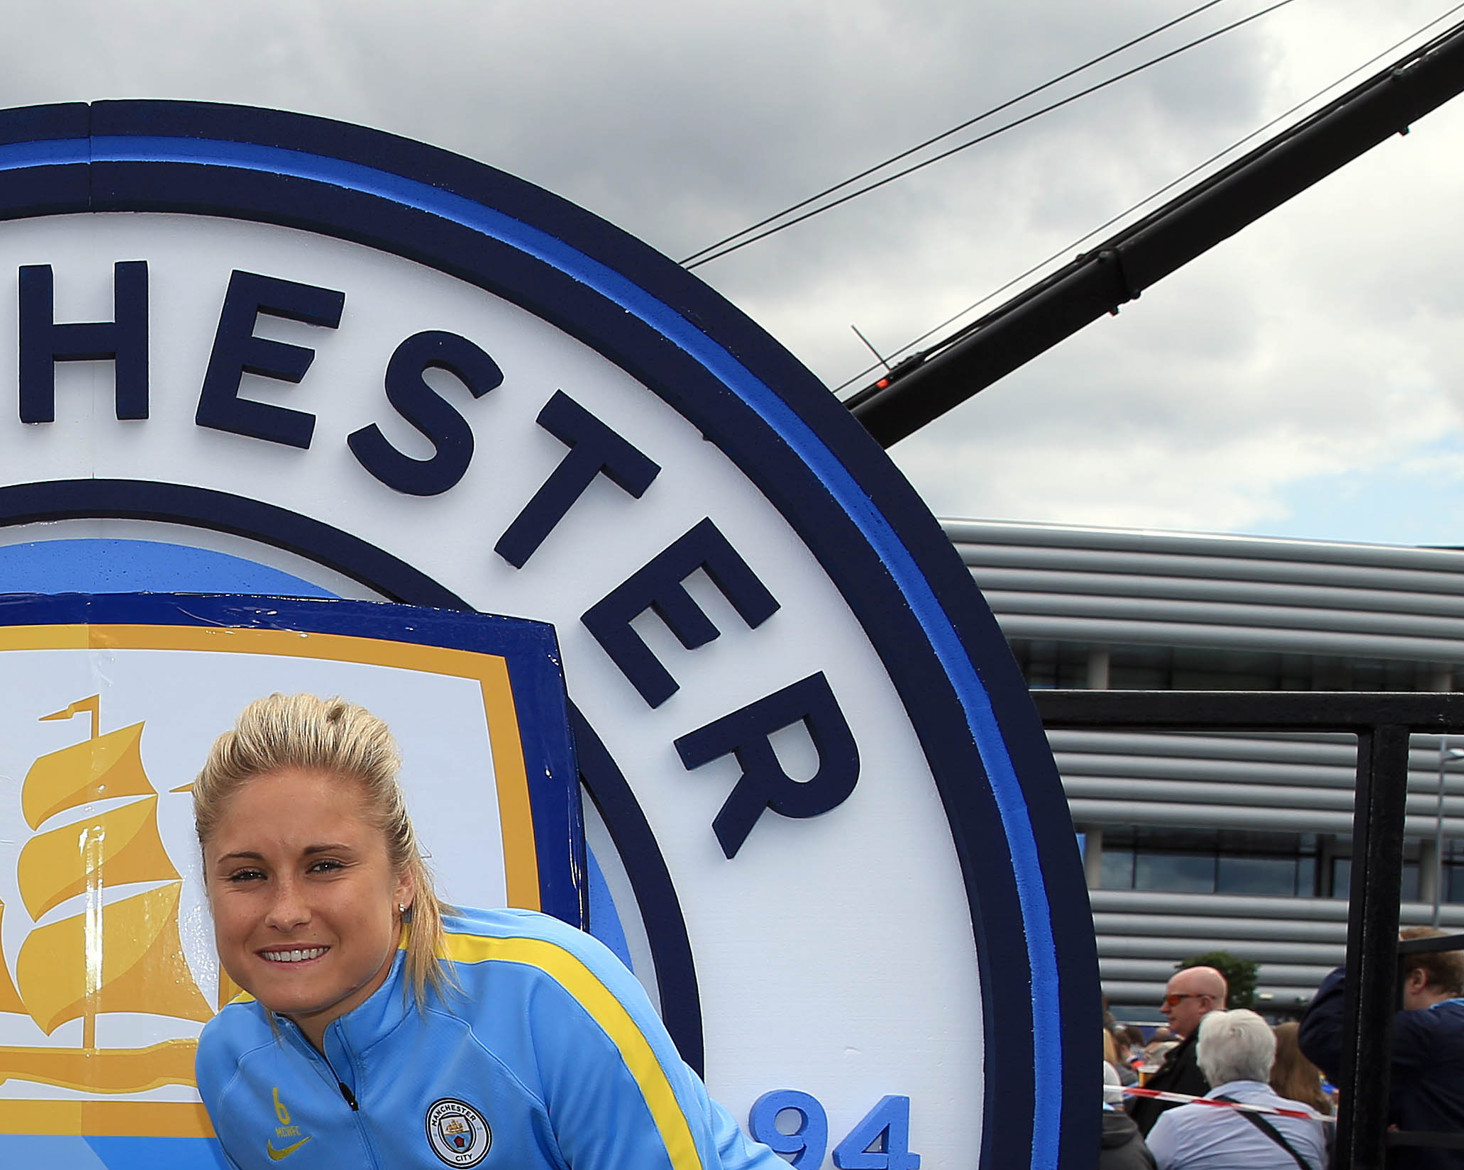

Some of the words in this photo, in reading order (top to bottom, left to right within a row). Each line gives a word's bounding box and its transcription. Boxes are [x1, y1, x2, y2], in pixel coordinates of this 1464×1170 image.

[272, 1087, 291, 1125] 6
[431, 1104, 477, 1127] MANCHESTER
[455, 1153, 473, 1162] CITY
